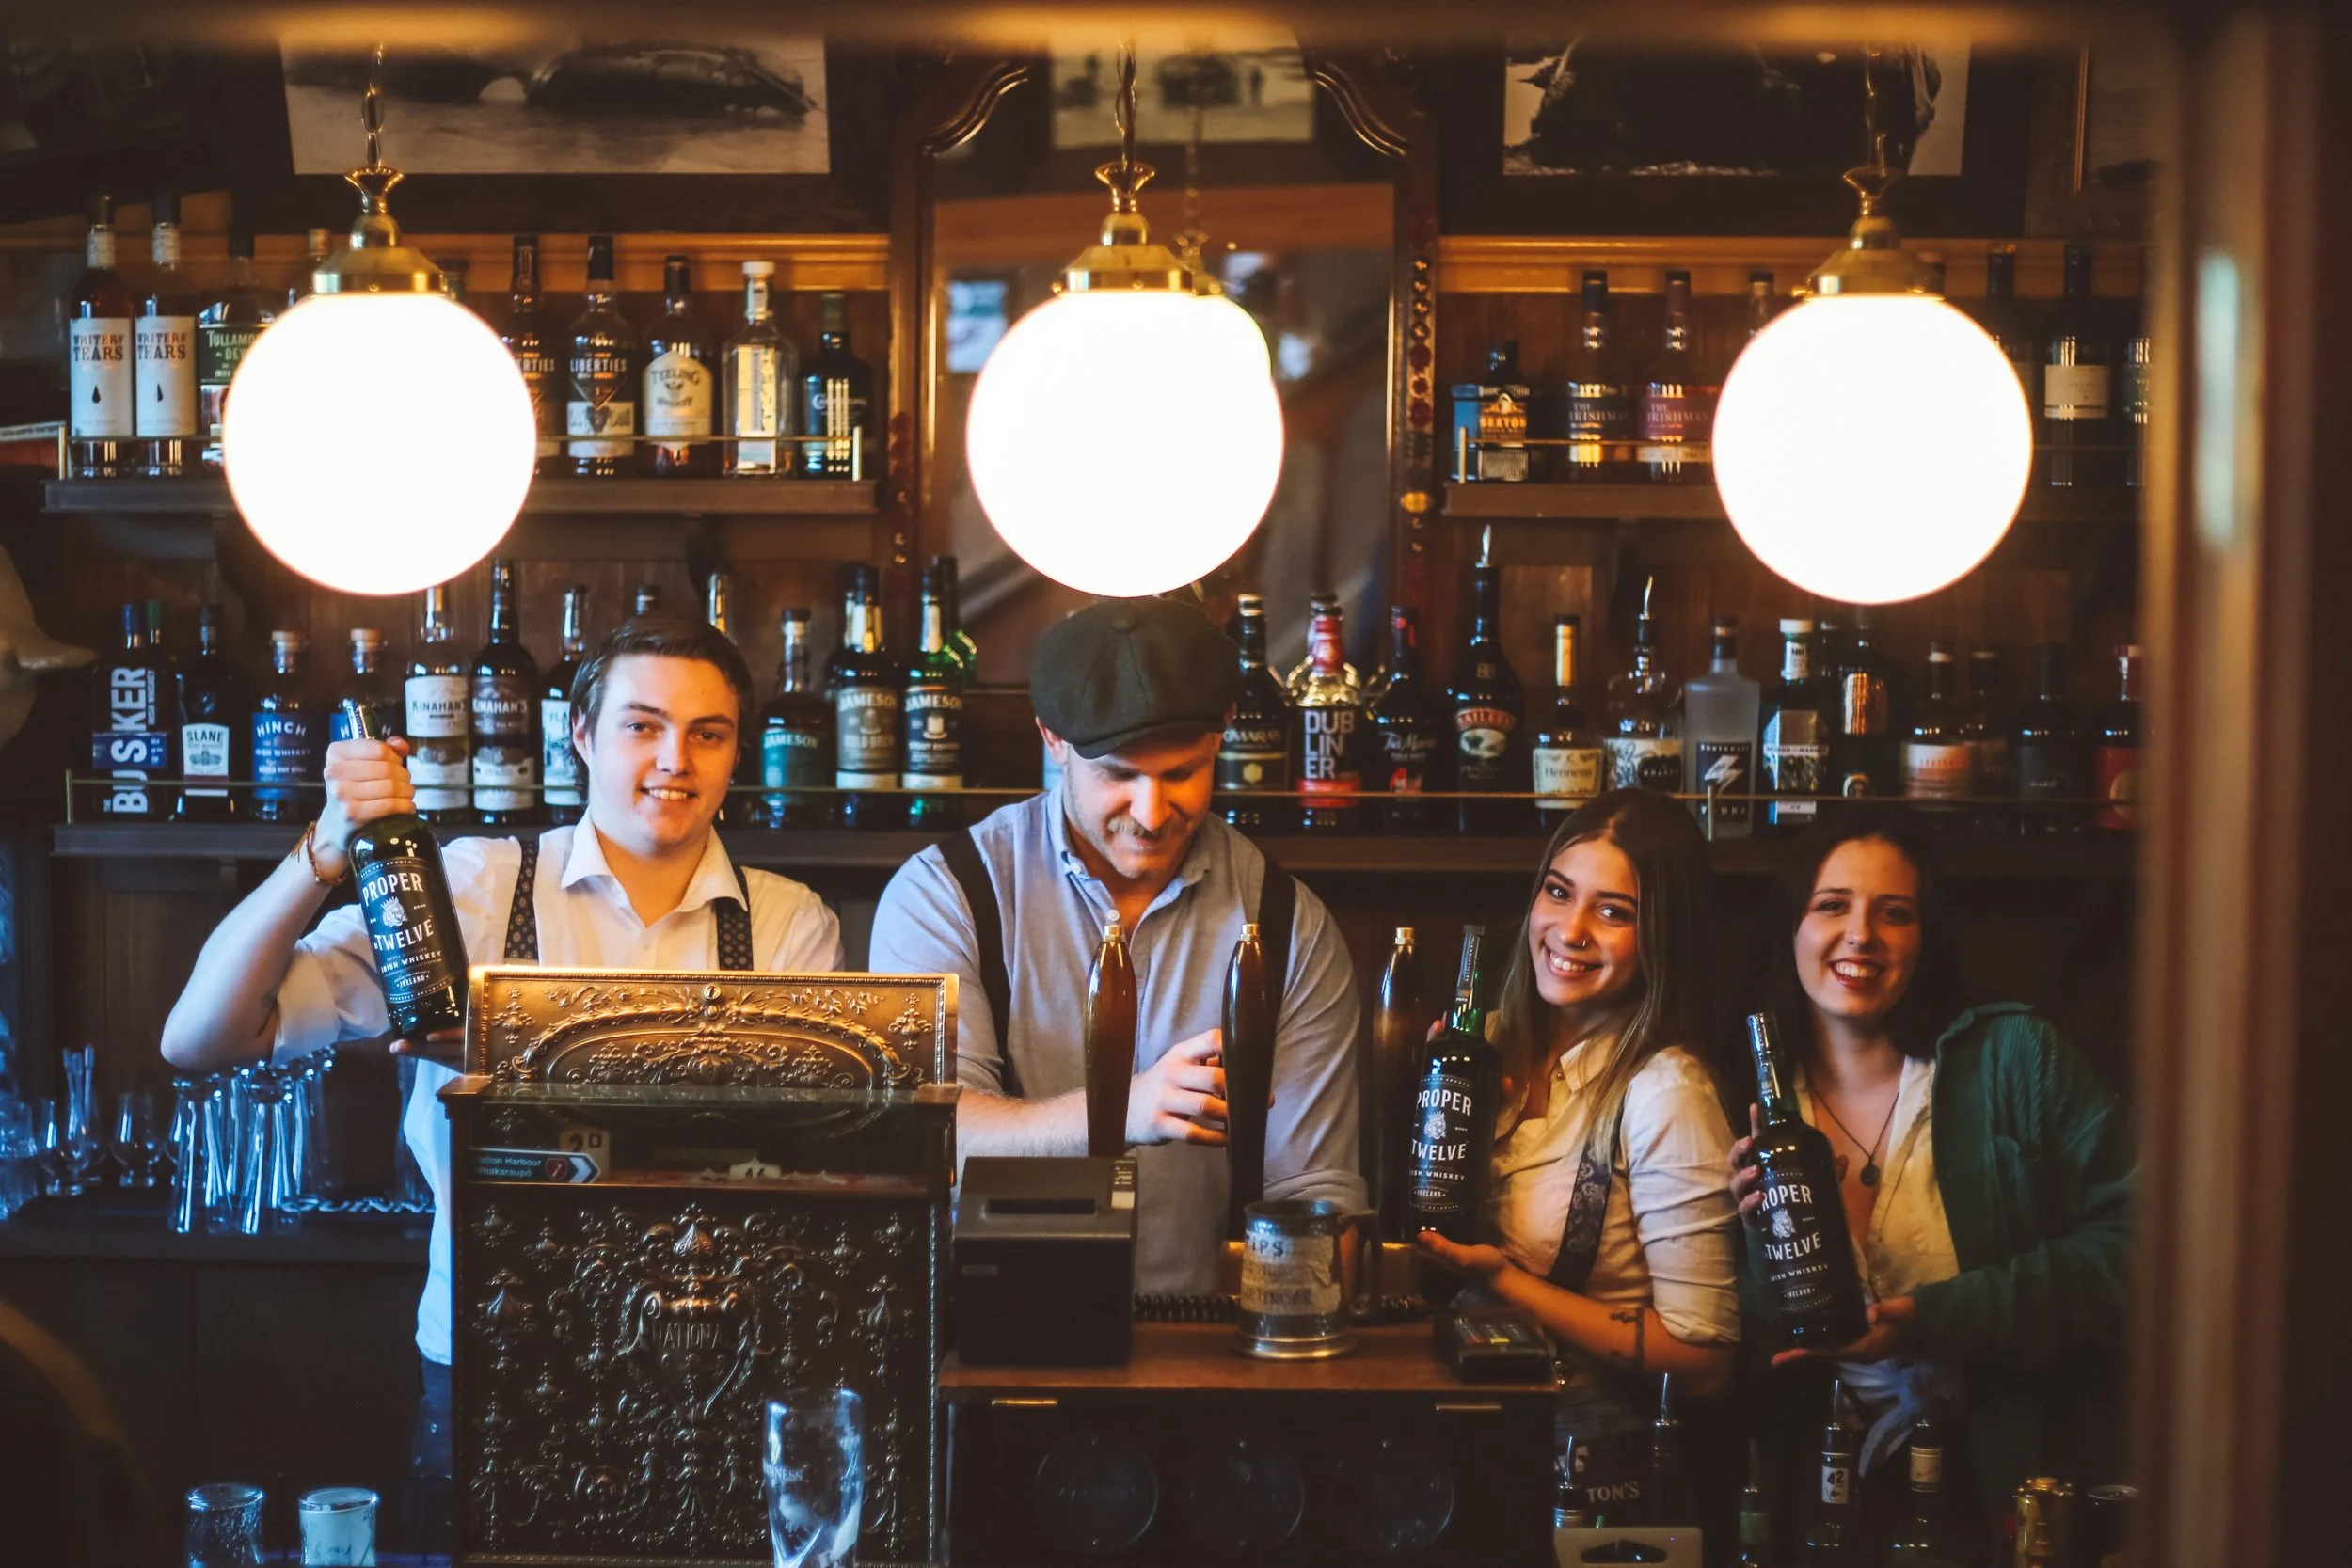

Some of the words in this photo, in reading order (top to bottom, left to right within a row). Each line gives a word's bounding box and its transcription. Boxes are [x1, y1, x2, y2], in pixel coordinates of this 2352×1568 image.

[206, 329, 257, 348] TULLAMO
[72, 344, 124, 362] TEARS
[136, 344, 187, 360] TEARS
[518, 358, 556, 372] ERTIES
[570, 358, 628, 372] LIBERTIES
[650, 368, 701, 386] TEELING
[1647, 411, 1708, 422] IRISHMAN
[256, 721, 308, 738] HINCH
[1304, 710, 1355, 734] DUB
[111, 667, 148, 813] BUSKER
[187, 730, 224, 743] SLANE
[763, 734, 820, 750] JAMESON
[1305, 734, 1344, 757] LIN
[1305, 756, 1336, 780] ER
[362, 872, 424, 908] PROPER
[373, 918, 435, 951] TWELVE
[381, 961, 399, 974] IRISH
[401, 950, 442, 966] WHISKEY
[1412, 1138, 1467, 1161] TWELVE
[505, 1157, 542, 1167] Harbour
[1425, 1169, 1465, 1180] WHISKEY
[1757, 1185, 1813, 1216] ROPER
[1765, 1231, 1821, 1261] TWELVE
[1788, 1263, 1828, 1277] WHISKEY
[652, 1322, 719, 1349] NATION
[1585, 1481, 1641, 1504] TON'S
